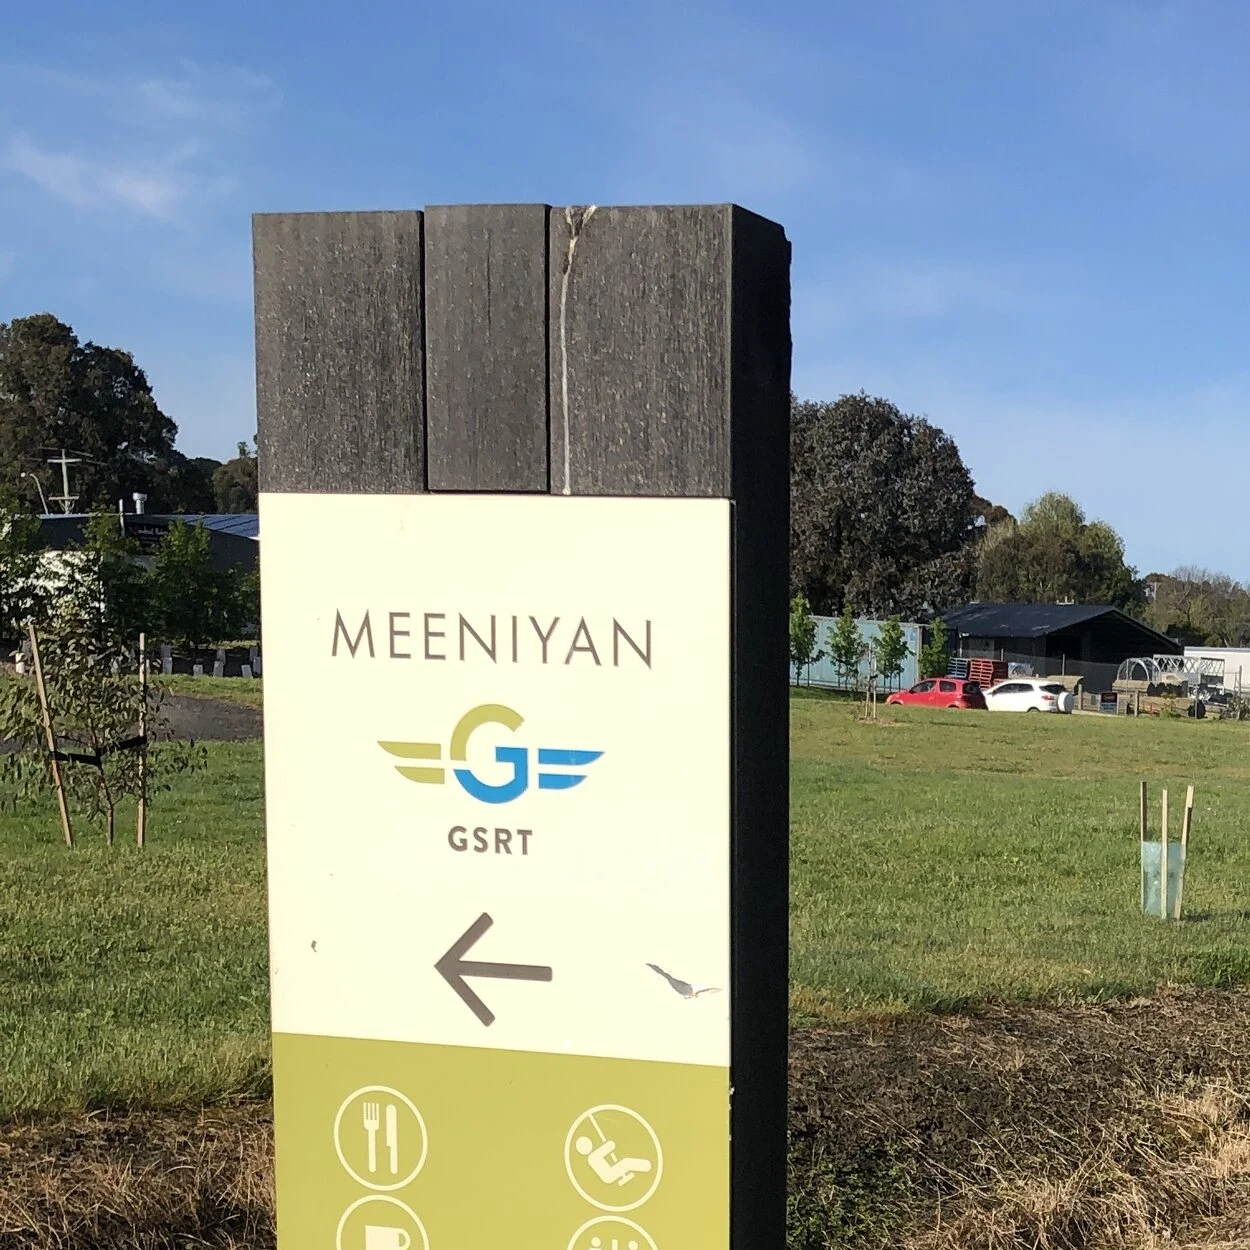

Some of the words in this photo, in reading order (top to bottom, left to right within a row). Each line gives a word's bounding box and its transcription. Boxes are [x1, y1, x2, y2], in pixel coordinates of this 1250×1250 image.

[331, 608, 652, 669] MEENIYAN
[450, 703, 528, 804] G
[448, 826, 532, 855] GSRT
